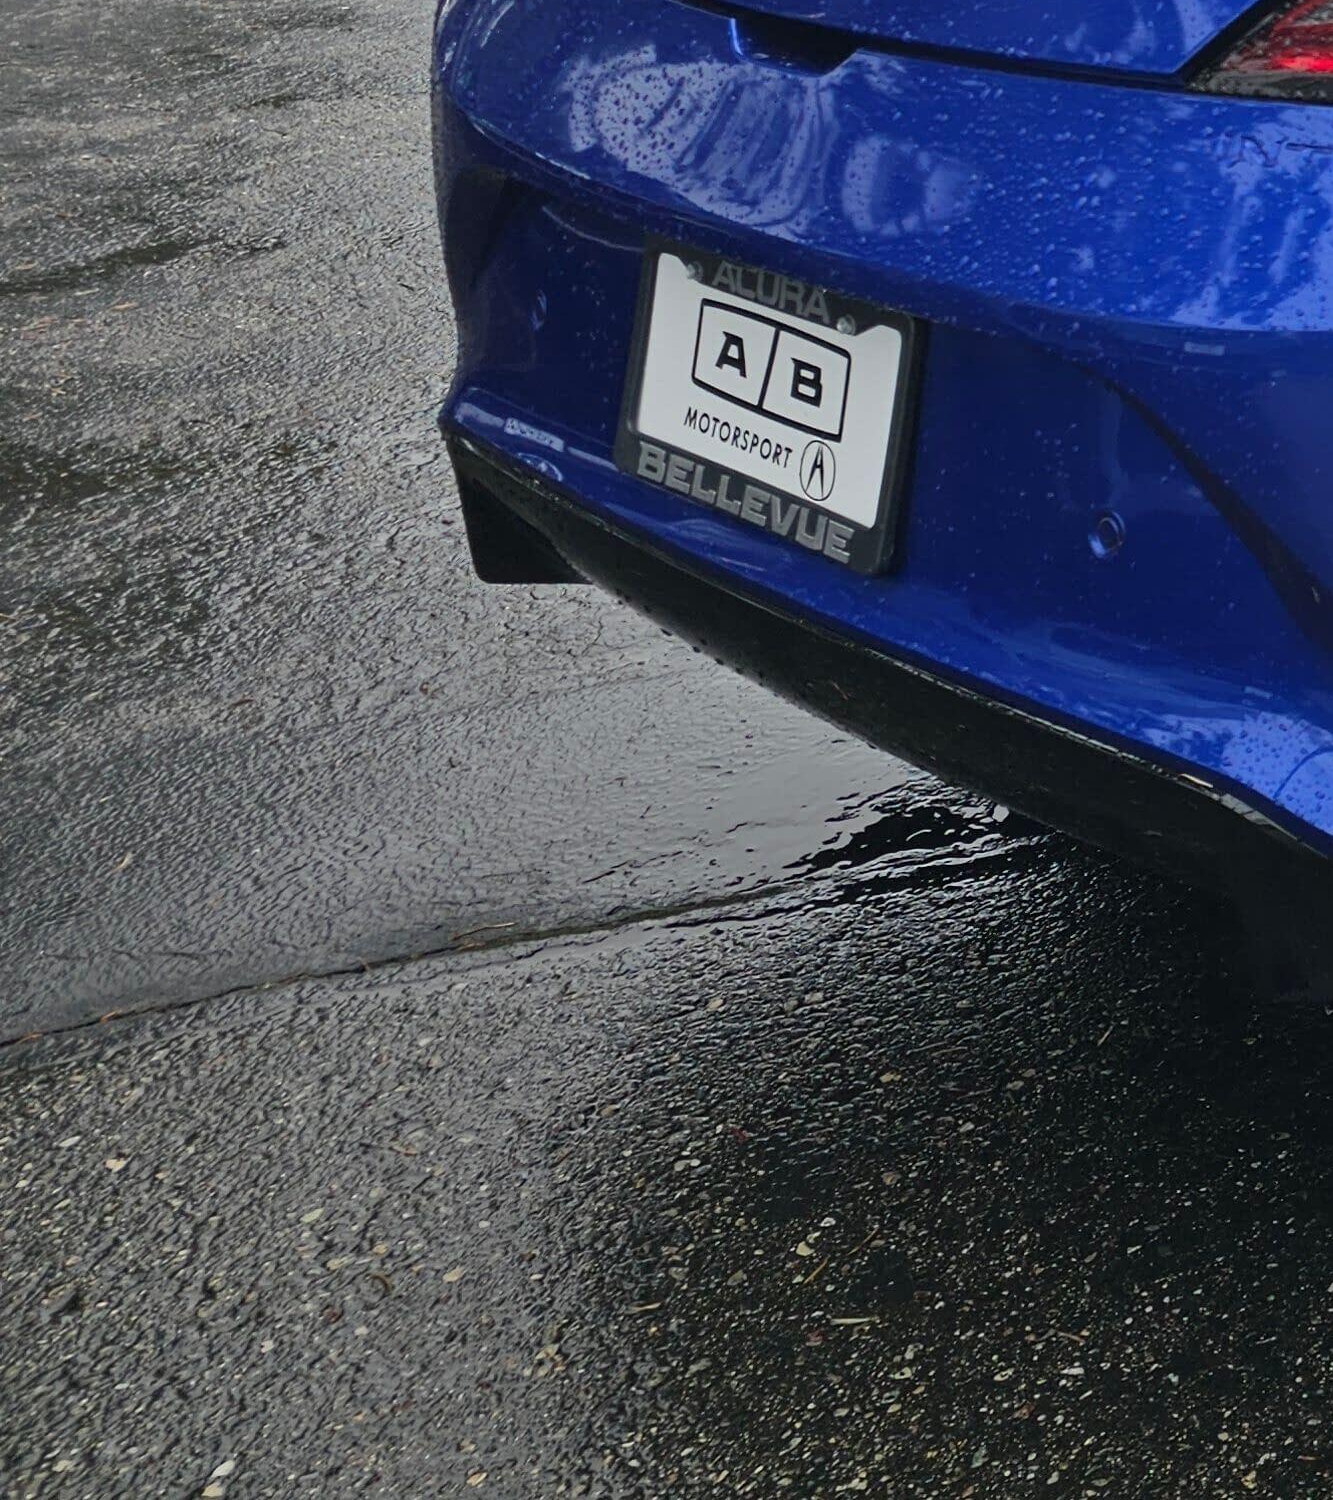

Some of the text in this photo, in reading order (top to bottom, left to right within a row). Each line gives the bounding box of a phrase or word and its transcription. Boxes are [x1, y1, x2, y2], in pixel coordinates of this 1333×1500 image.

[711, 259, 832, 325] ACURA
[714, 330, 823, 408] A B
[683, 406, 793, 468] MOTORSPORT
[636, 440, 855, 565] BELLEVUE
